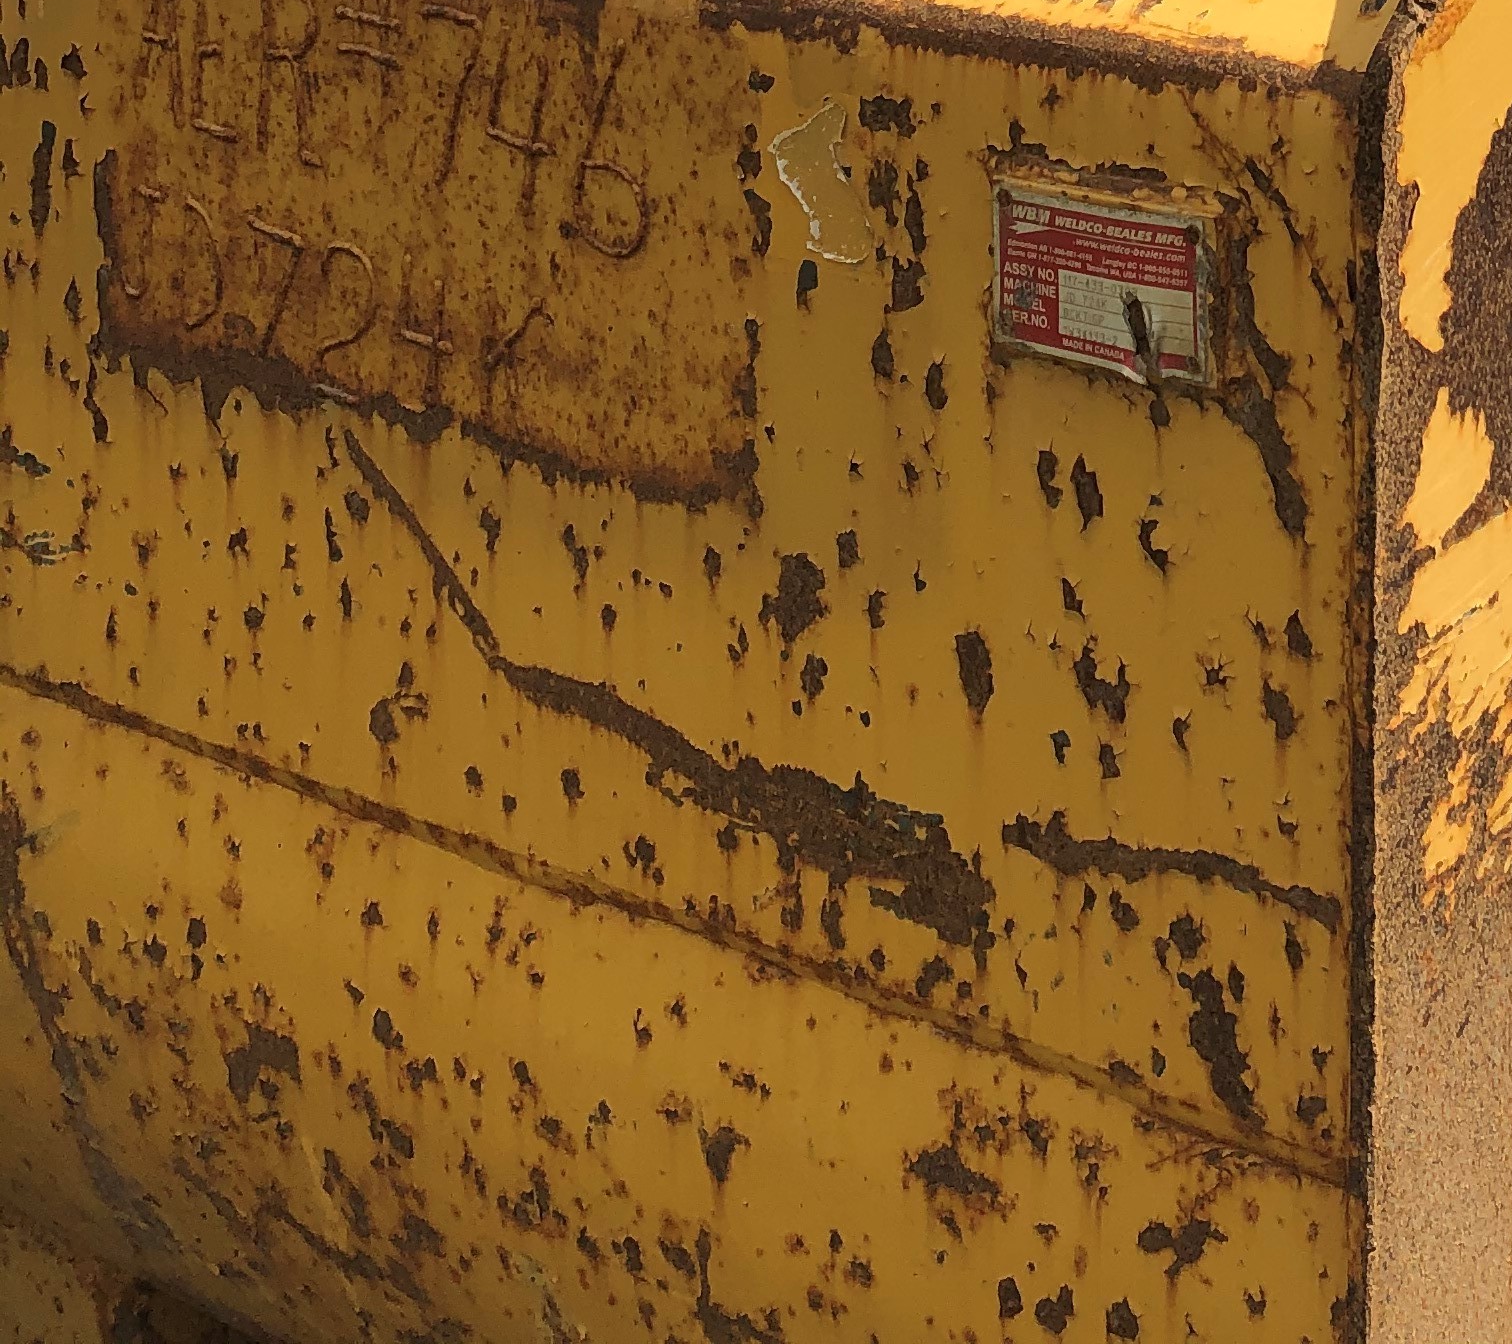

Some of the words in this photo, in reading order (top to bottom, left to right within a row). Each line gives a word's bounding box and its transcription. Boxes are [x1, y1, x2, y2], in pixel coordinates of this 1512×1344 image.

[1011, 203, 1051, 224] WBM
[1054, 215, 1153, 242] WELDCO-BEALES
[1154, 232, 1187, 247] MFG.
[1075, 238, 1186, 262] www.weldco-beales.com
[1003, 261, 1036, 278] ASSY
[1037, 267, 1057, 283] NO.
[1003, 292, 1046, 313] MEL
[1002, 308, 1051, 330] ER.NO.
[1062, 338, 1084, 350] MADE
[1084, 343, 1093, 352] IN
[1094, 345, 1125, 361] CANADA
